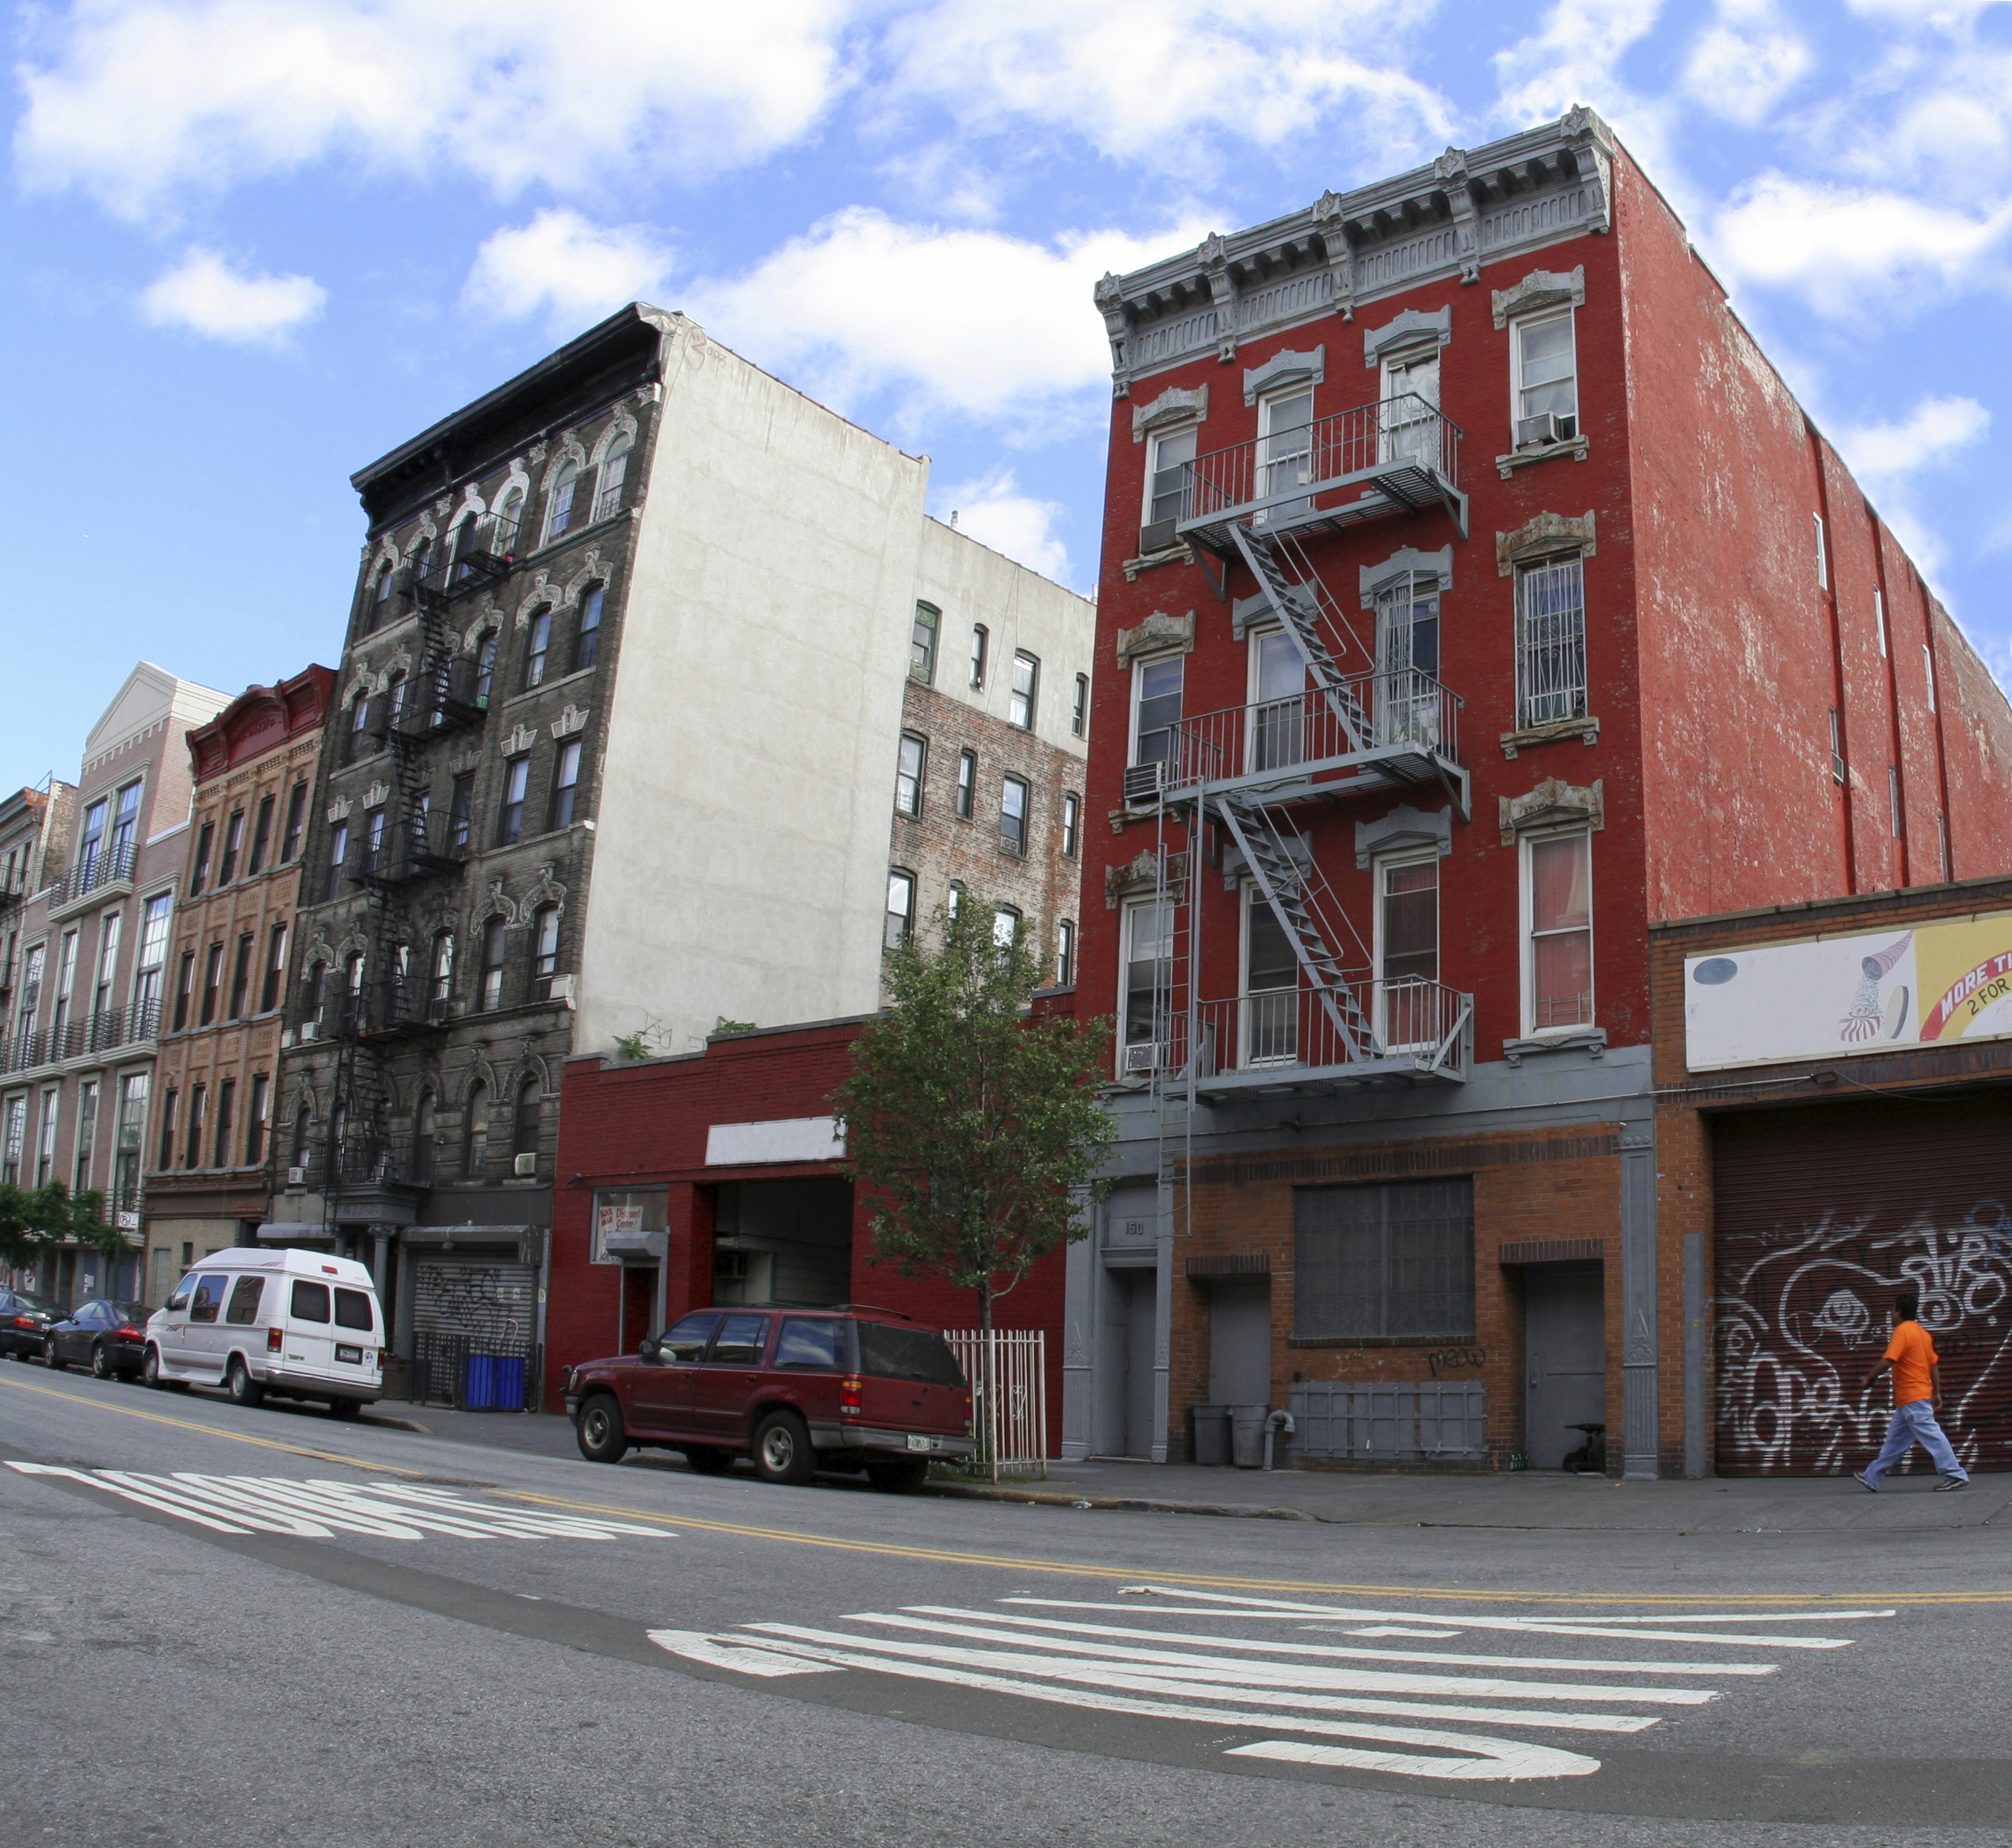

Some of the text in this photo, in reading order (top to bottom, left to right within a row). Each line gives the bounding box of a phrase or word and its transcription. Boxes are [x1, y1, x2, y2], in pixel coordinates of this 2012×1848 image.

[1941, 963, 1988, 1023] MORE
[1967, 978, 2010, 1016] 2 FOR
[1126, 1222, 1143, 1235] 150
[3, 1461, 679, 1540] SCHOOL
